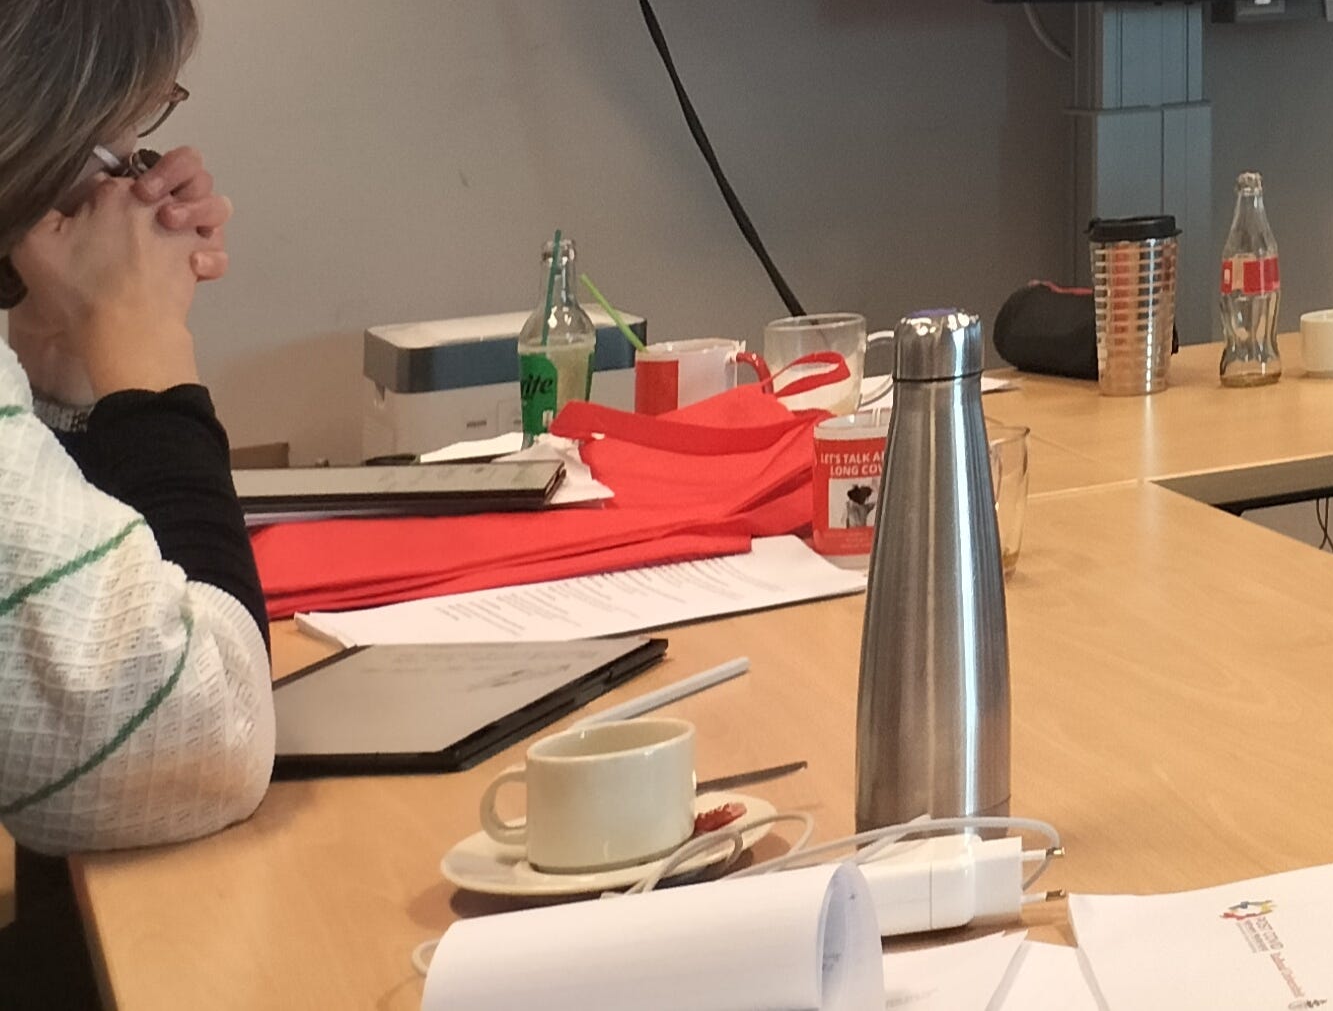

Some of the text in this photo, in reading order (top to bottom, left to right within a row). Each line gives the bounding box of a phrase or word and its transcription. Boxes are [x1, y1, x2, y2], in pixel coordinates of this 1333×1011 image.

[820, 452, 841, 465] LET'S
[843, 451, 869, 465] TALK
[830, 465, 858, 477] LONG
